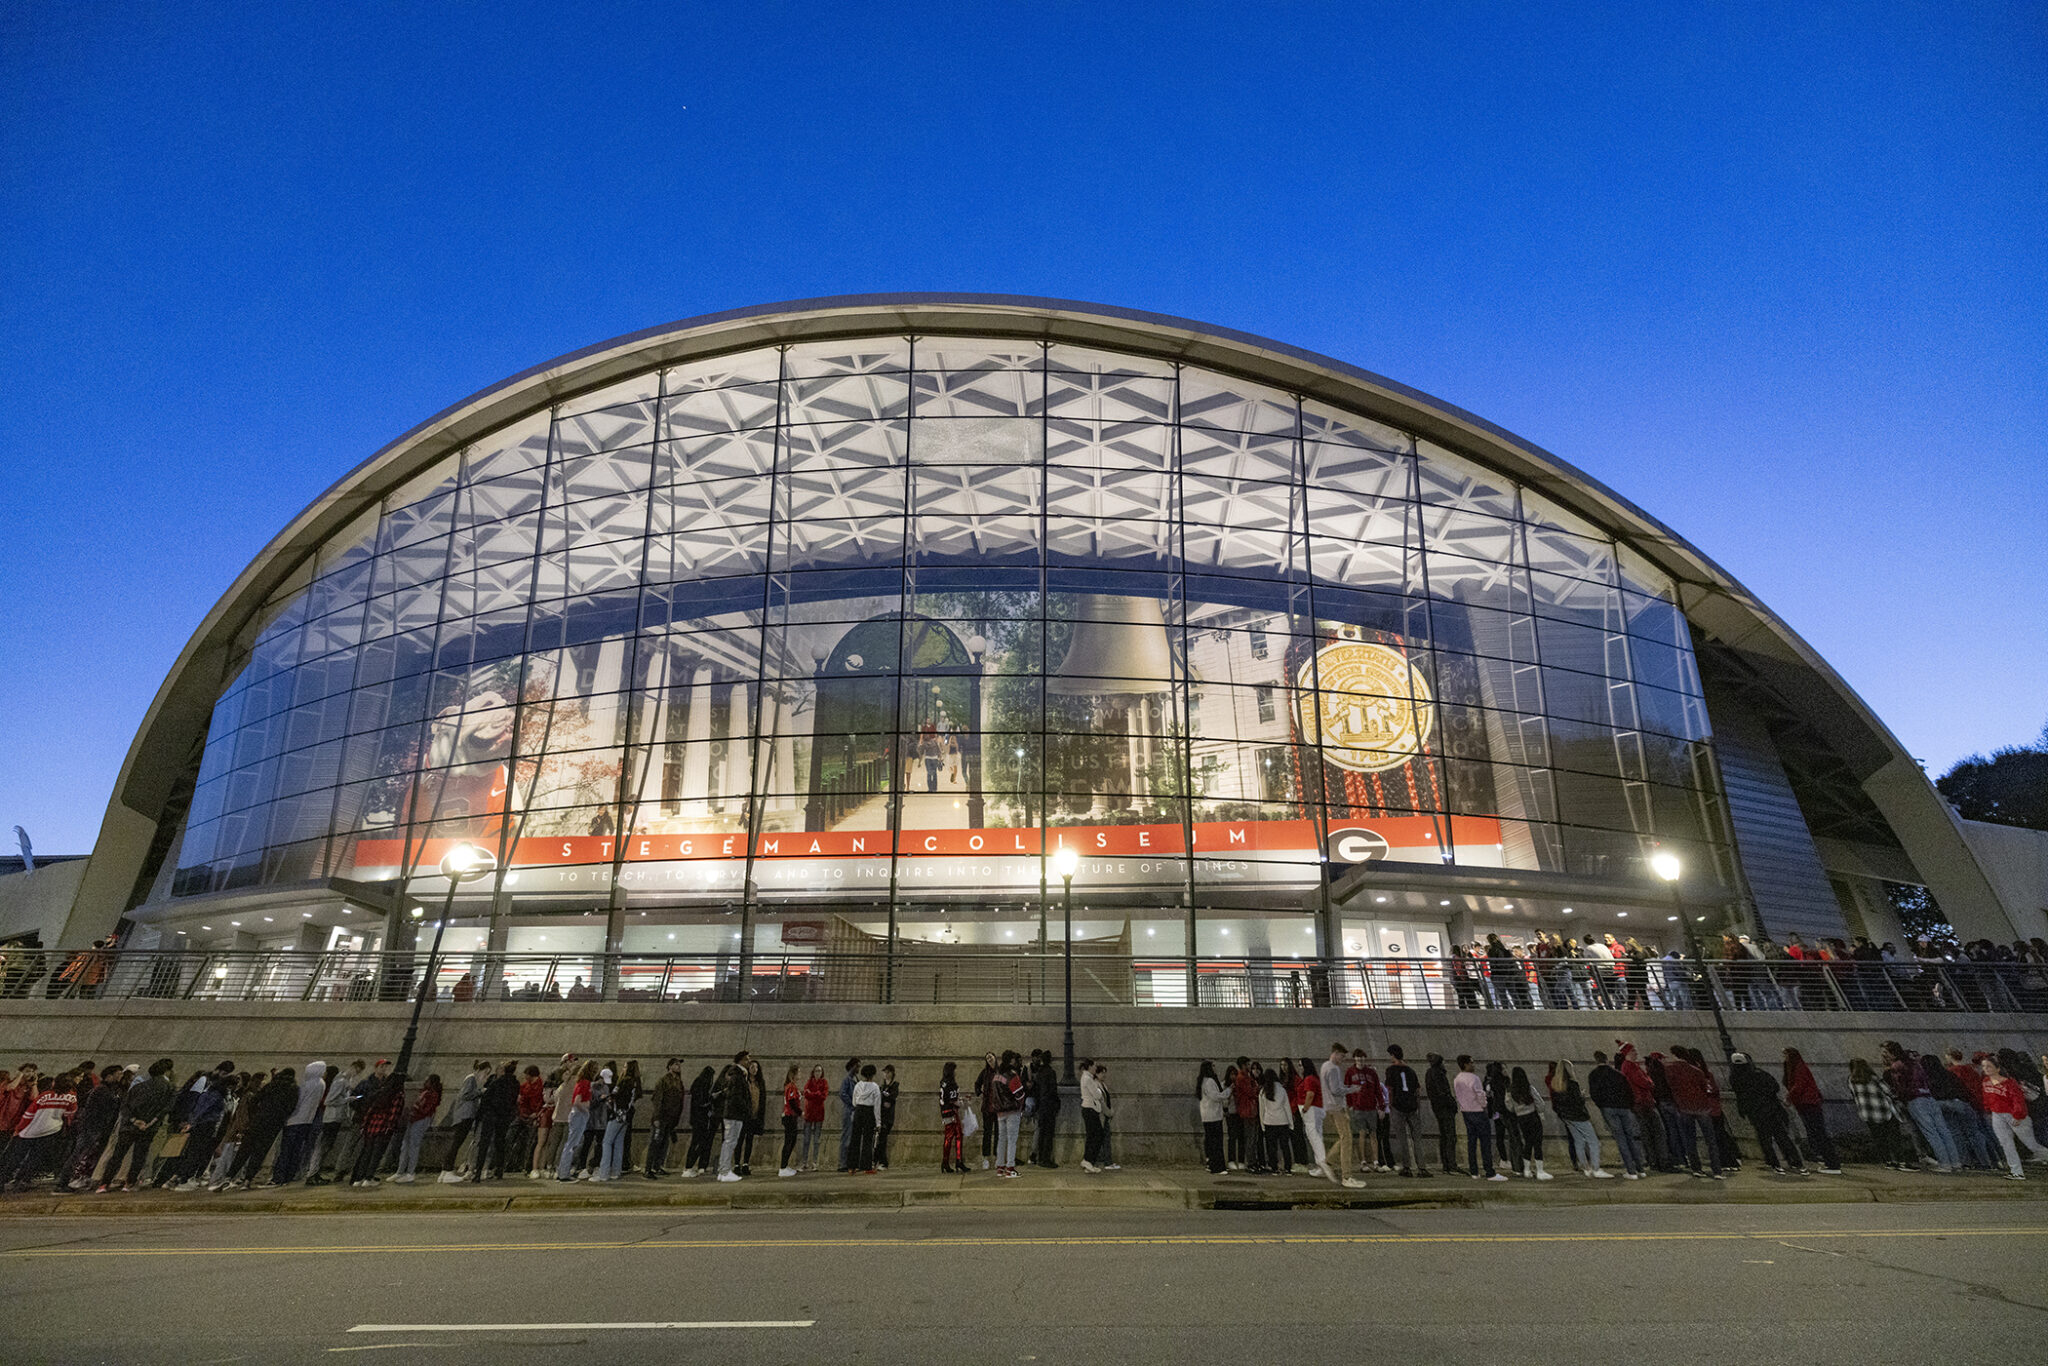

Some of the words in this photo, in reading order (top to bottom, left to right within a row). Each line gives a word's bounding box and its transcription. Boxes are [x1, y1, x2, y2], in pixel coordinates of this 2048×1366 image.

[562, 837, 865, 857] STEGEMAN
[559, 871, 578, 882] TO
[591, 871, 653, 882] TECH,
[665, 869, 685, 880] TO
[774, 867, 809, 880] AND
[822, 868, 843, 879] TO
[857, 866, 936, 878] INQUIRE
[948, 866, 992, 877] INTO
[1005, 864, 1042, 876] THE
[1140, 862, 1163, 873] OF
[1178, 861, 1249, 872] THINGS
